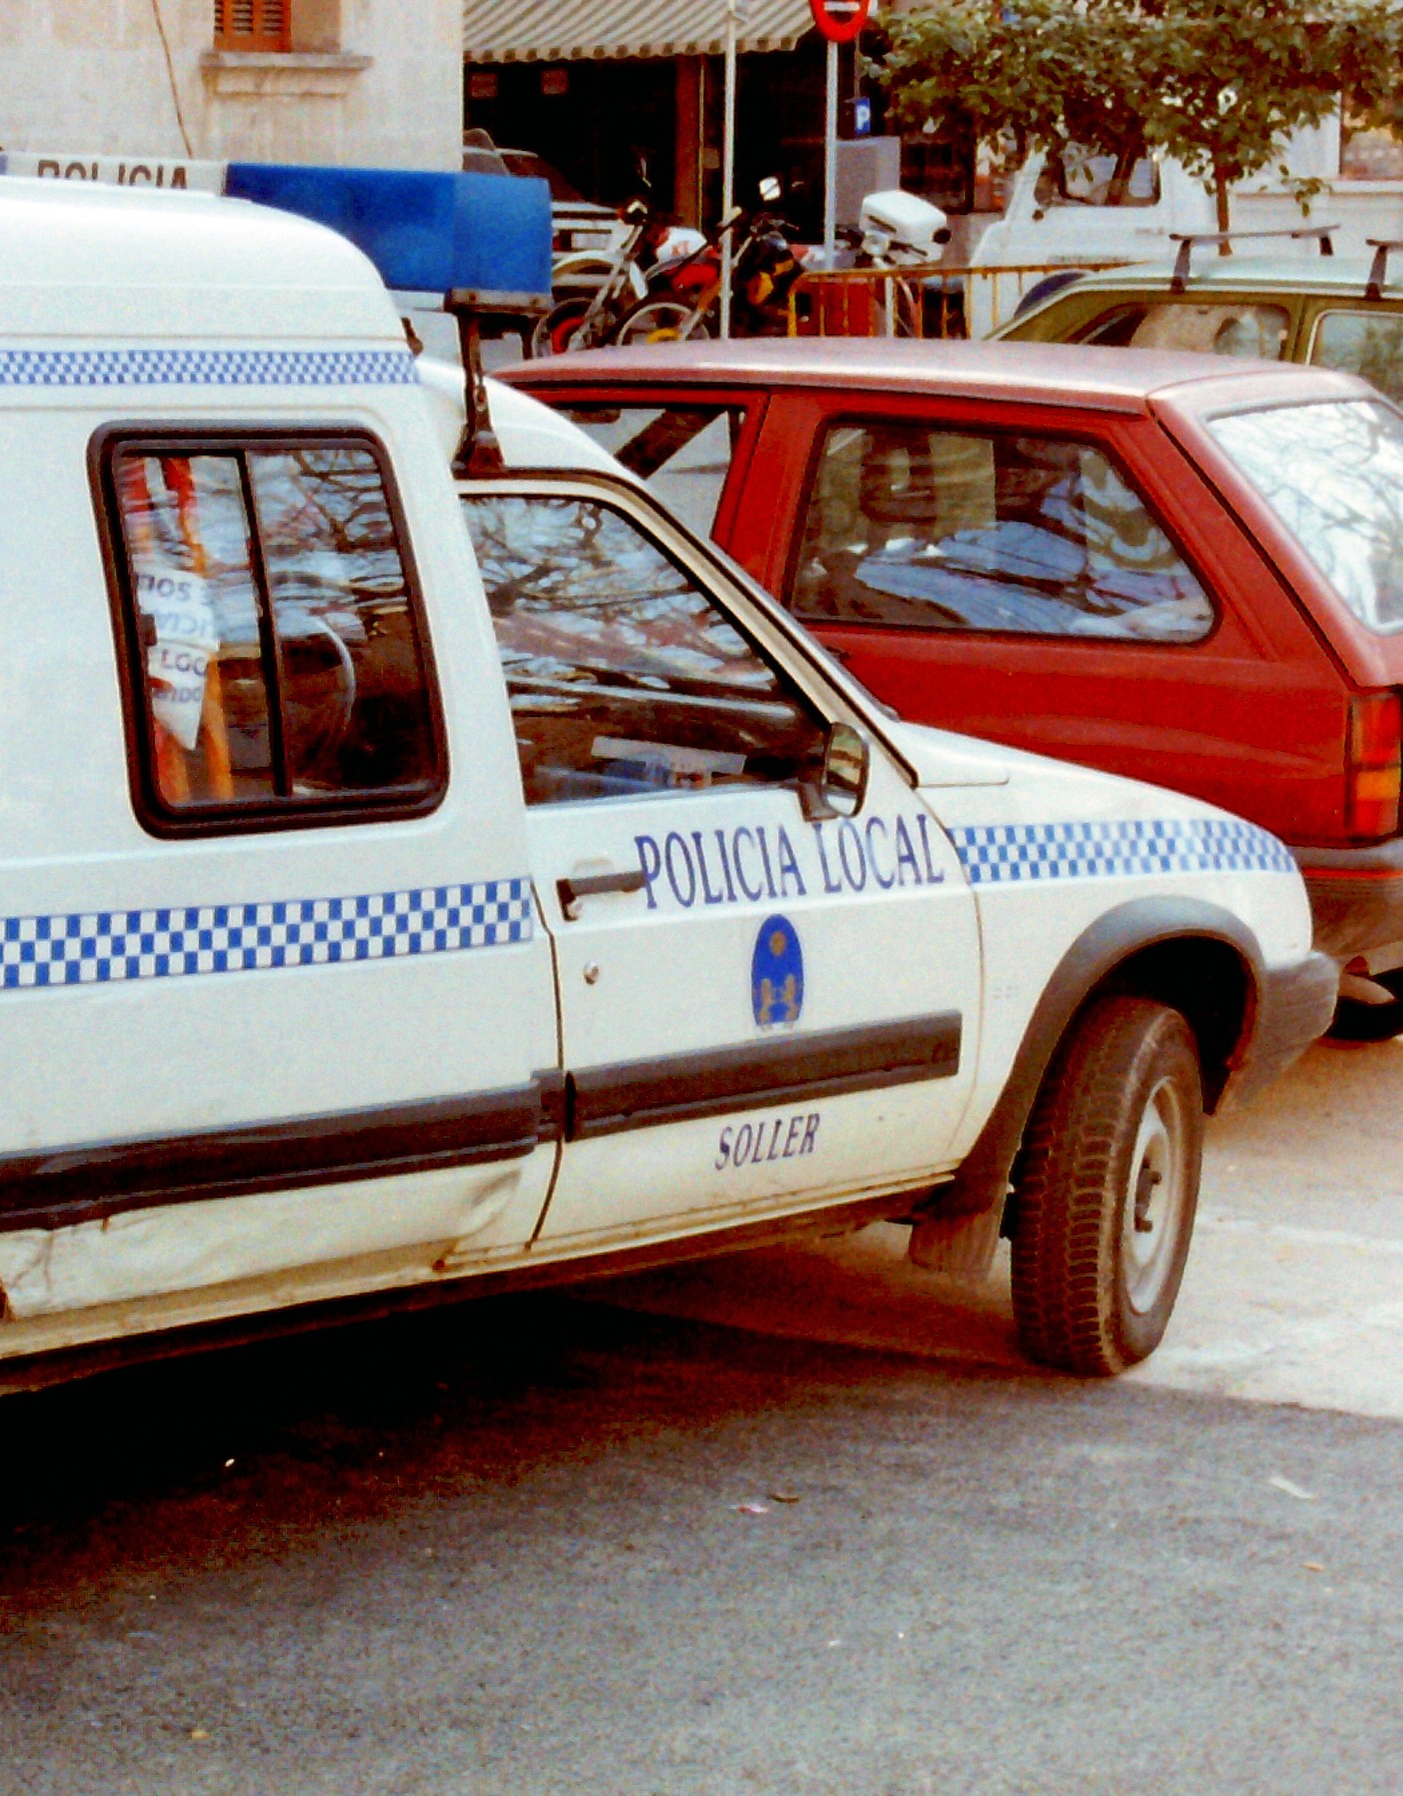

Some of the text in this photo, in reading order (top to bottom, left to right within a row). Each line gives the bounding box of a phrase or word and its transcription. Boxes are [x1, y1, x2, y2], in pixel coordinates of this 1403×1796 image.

[857, 105, 871, 131] P
[634, 814, 945, 909] POLICIA LOCAL
[715, 1113, 821, 1170] SOLLER
